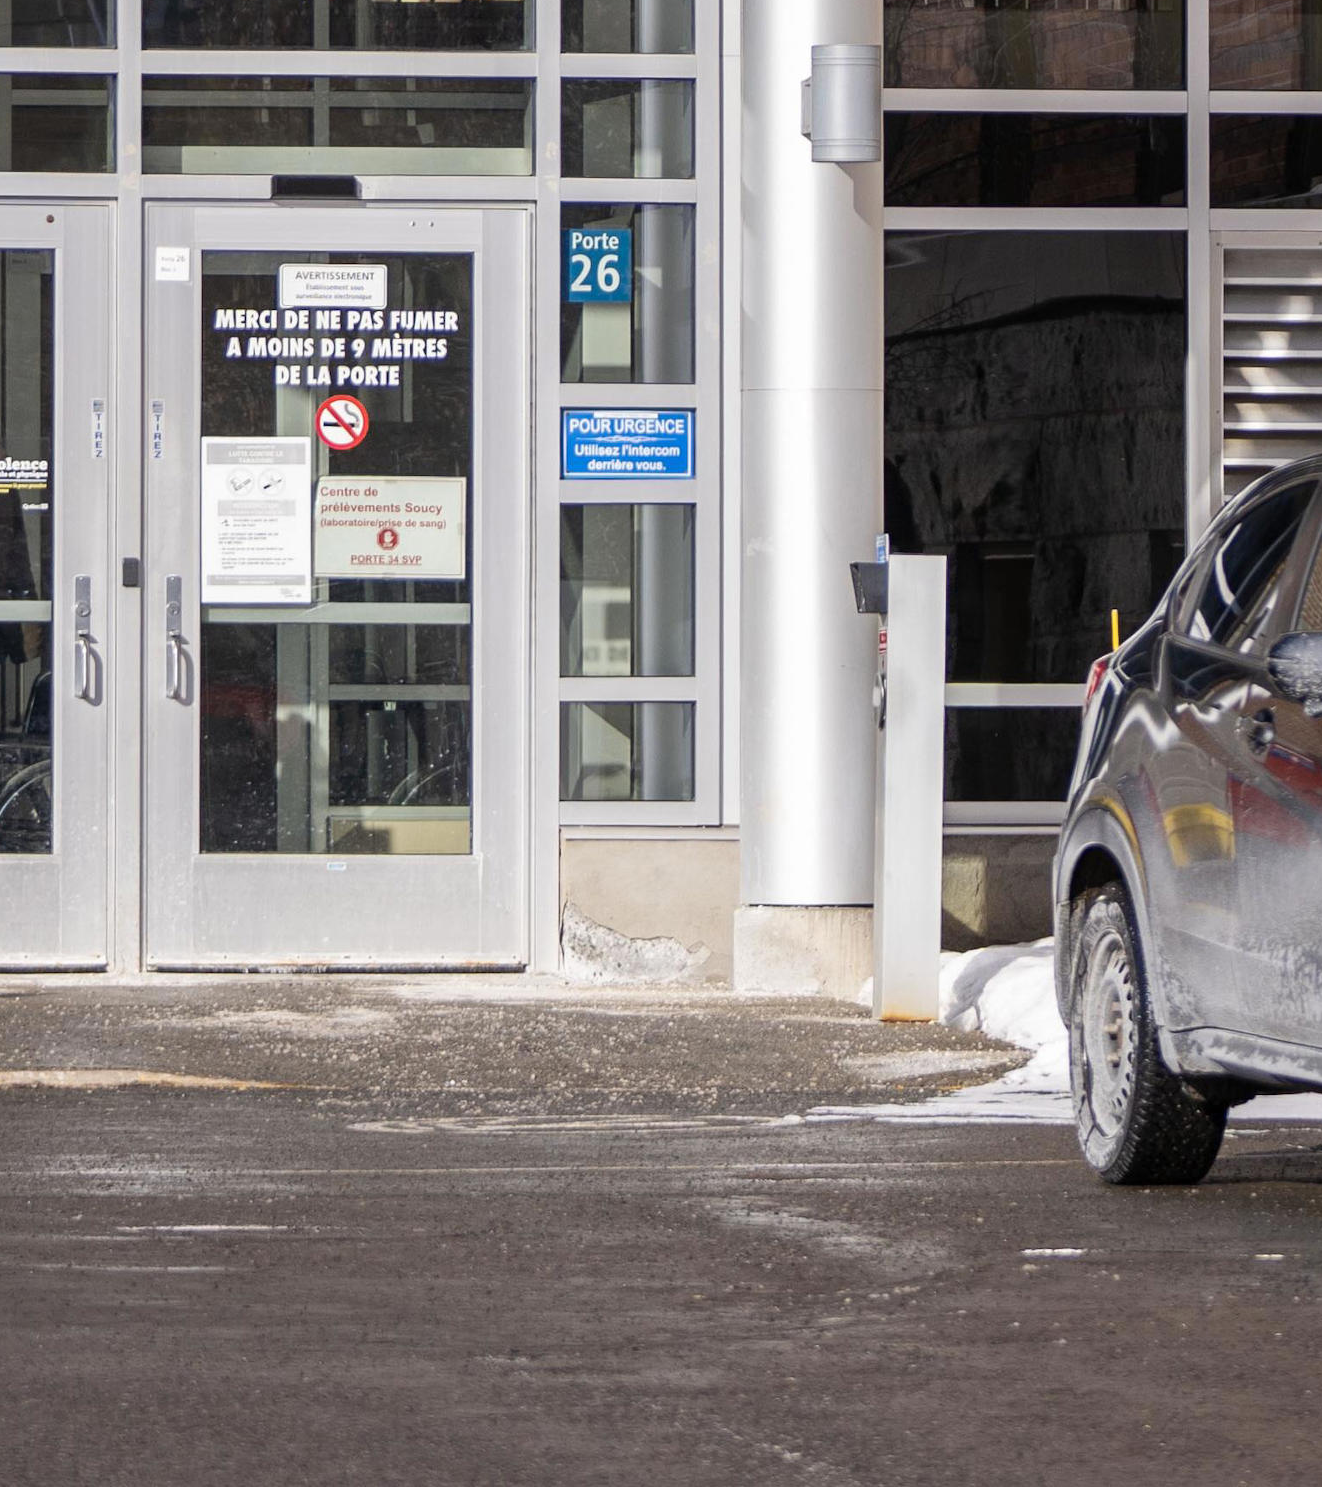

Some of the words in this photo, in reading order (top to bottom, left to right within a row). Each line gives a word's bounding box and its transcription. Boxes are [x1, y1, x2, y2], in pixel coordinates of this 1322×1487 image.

[572, 232, 619, 250] Porte
[295, 271, 375, 281] AVERTISSEMENT
[569, 254, 620, 292] 26
[214, 309, 278, 329] MERCI
[284, 310, 310, 330] DE
[316, 310, 341, 330] NE
[347, 310, 384, 331] PAS
[390, 311, 458, 331] FUMER
[226, 337, 242, 357] A
[247, 337, 314, 358] MOINS
[320, 338, 346, 358] DE
[351, 338, 366, 358] 9
[371, 333, 448, 359] MÈTRES
[275, 365, 301, 385] DE
[307, 366, 332, 385] LA
[337, 365, 400, 386] PORTE
[569, 418, 612, 433] POUR
[614, 419, 685, 434] URGENCE
[574, 444, 620, 456] Utilisez
[621, 444, 681, 457] l'intercom
[587, 459, 634, 470] derrière
[635, 461, 667, 471] vous.
[320, 486, 360, 497] Centre
[364, 486, 378, 497] de
[321, 502, 401, 514] prélèvements
[404, 502, 443, 515] Soucy
[405, 519, 417, 528] de
[419, 519, 447, 530] sang)
[350, 554, 385, 564] PORTE
[402, 555, 422, 564] SVP
